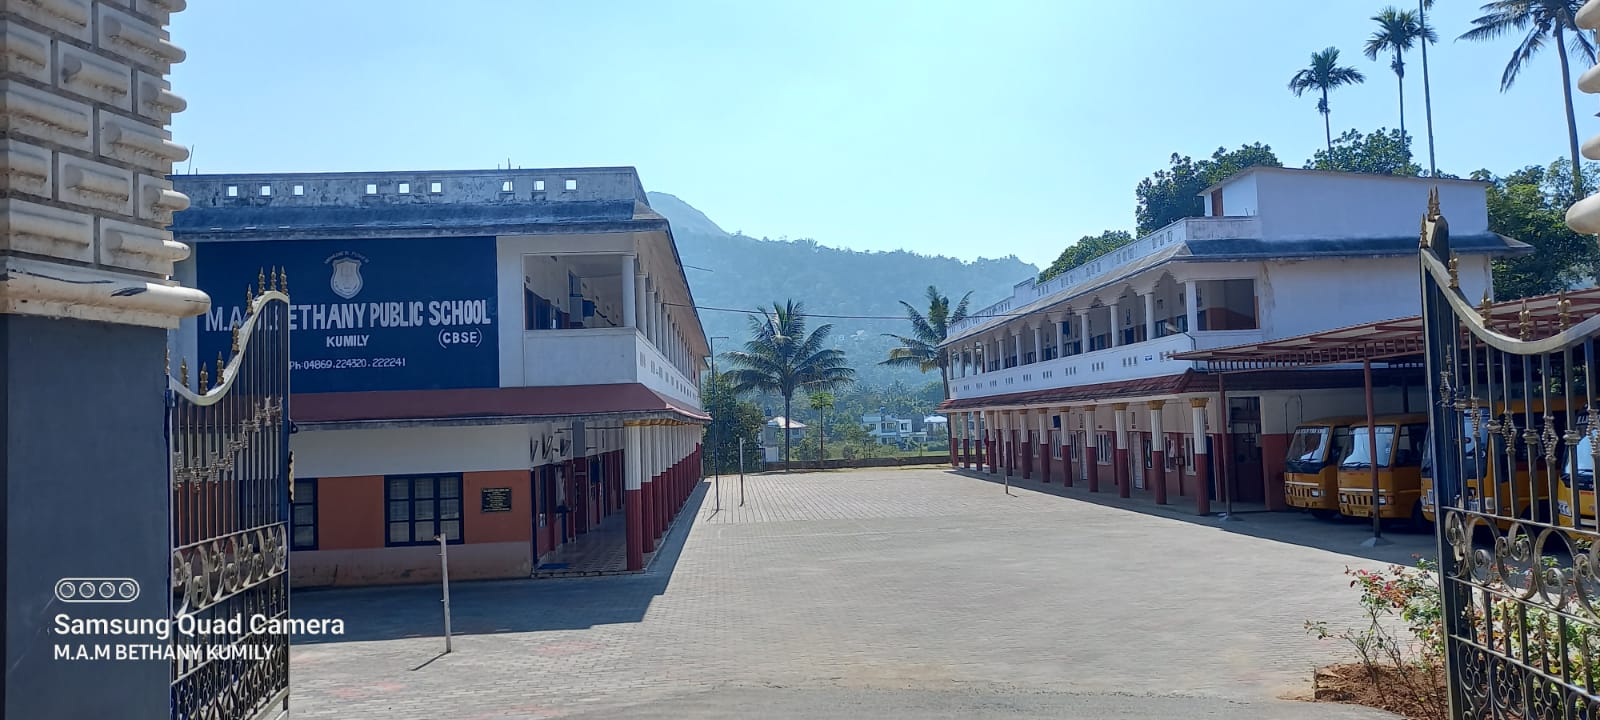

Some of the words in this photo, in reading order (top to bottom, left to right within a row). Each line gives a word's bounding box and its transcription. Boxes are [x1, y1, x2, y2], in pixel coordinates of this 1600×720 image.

[369, 301, 424, 328] PUBLIC
[428, 299, 492, 326] SCHOOL
[326, 334, 370, 347] KUMILY
[438, 327, 483, 349] (CBSE)
